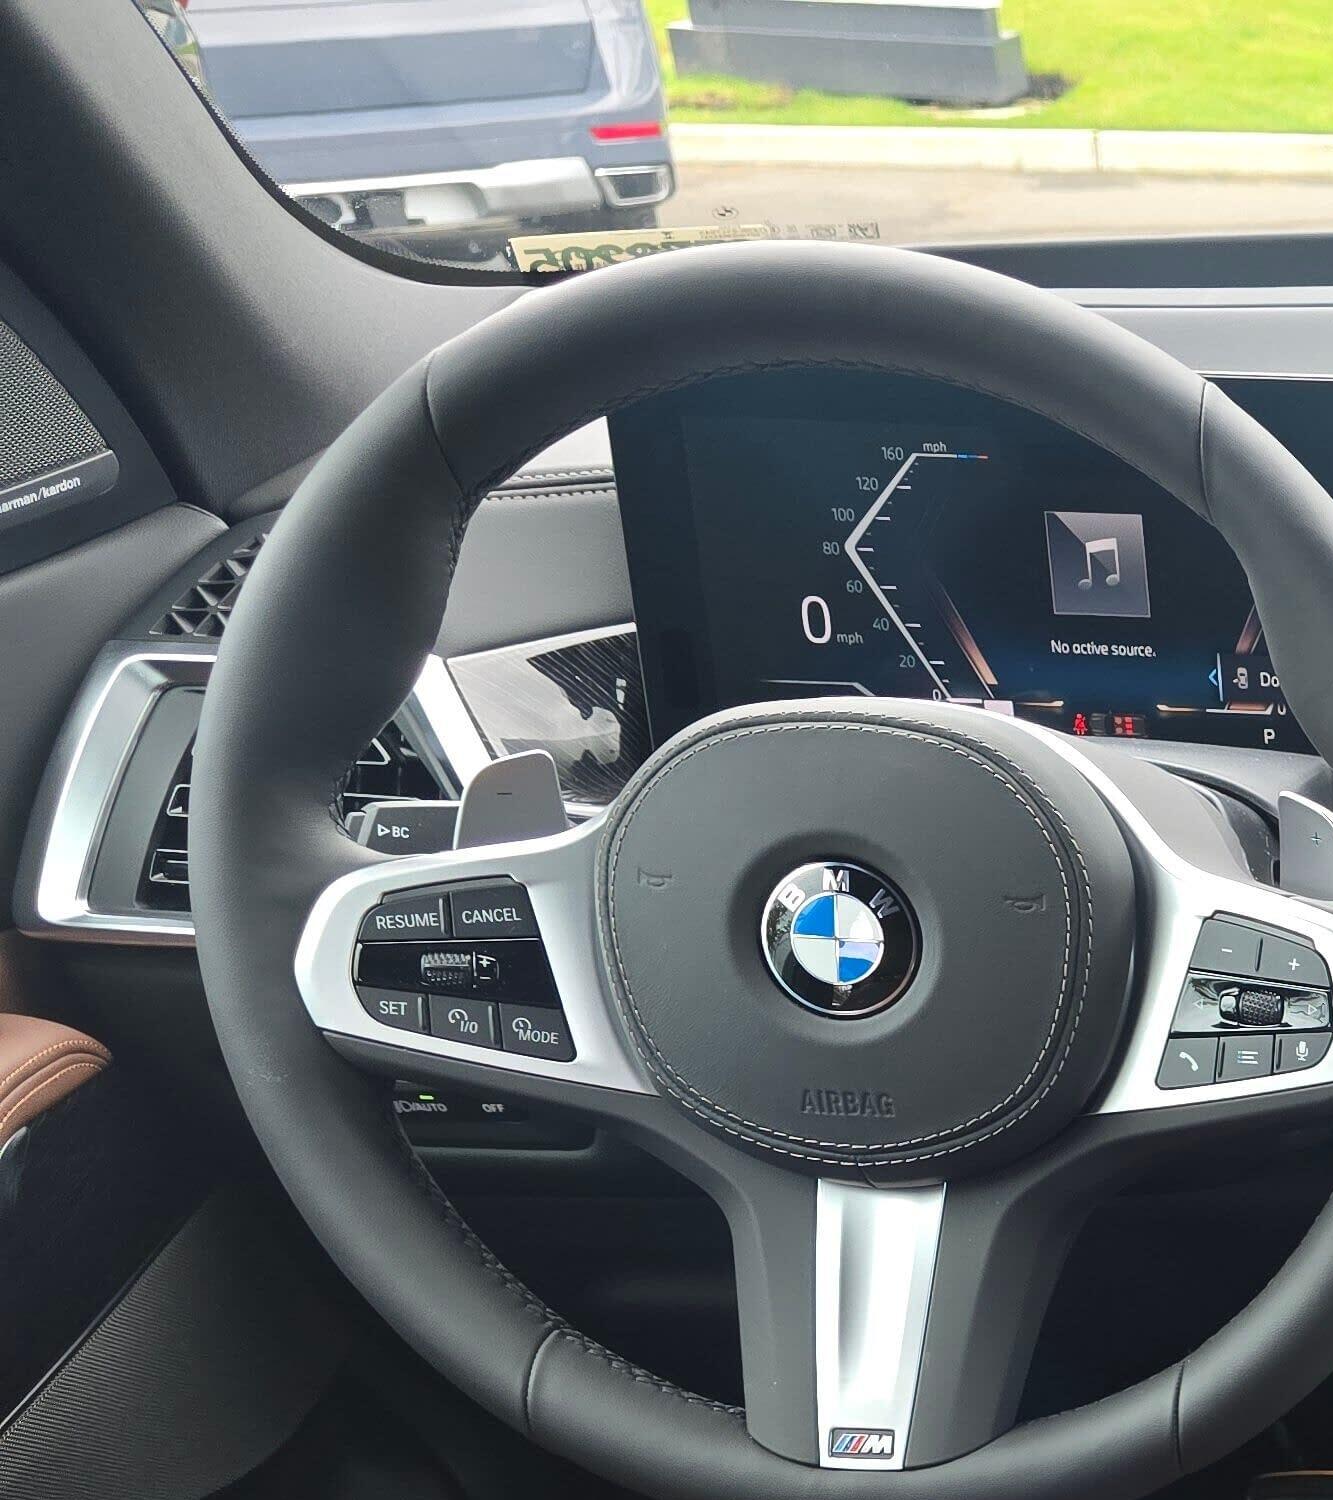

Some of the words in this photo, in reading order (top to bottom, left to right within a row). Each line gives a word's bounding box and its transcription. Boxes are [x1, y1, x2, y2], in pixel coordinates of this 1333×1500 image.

[881, 446, 904, 461] 160
[922, 441, 947, 453] mph
[856, 476, 879, 491] 120
[0, 477, 81, 514] arman/kardon
[831, 507, 855, 522] 100
[822, 541, 840, 555] 80
[846, 579, 863, 594] 60
[801, 595, 832, 644] 0
[836, 632, 864, 645] mph
[872, 617, 889, 632] 40
[1050, 640, 1070, 654] No
[1072, 641, 1109, 656] active
[1110, 645, 1157, 658] source.
[899, 654, 916, 669] 20
[1263, 728, 1275, 744] P
[391, 825, 410, 839] BC
[777, 868, 900, 920] BMW
[375, 912, 440, 930] RESUME
[461, 907, 522, 924] CANCEL
[379, 1001, 408, 1016] SET
[518, 1029, 559, 1045] MODE
[481, 1103, 505, 1113] OFF
[801, 1088, 896, 1118] AIRBAG
